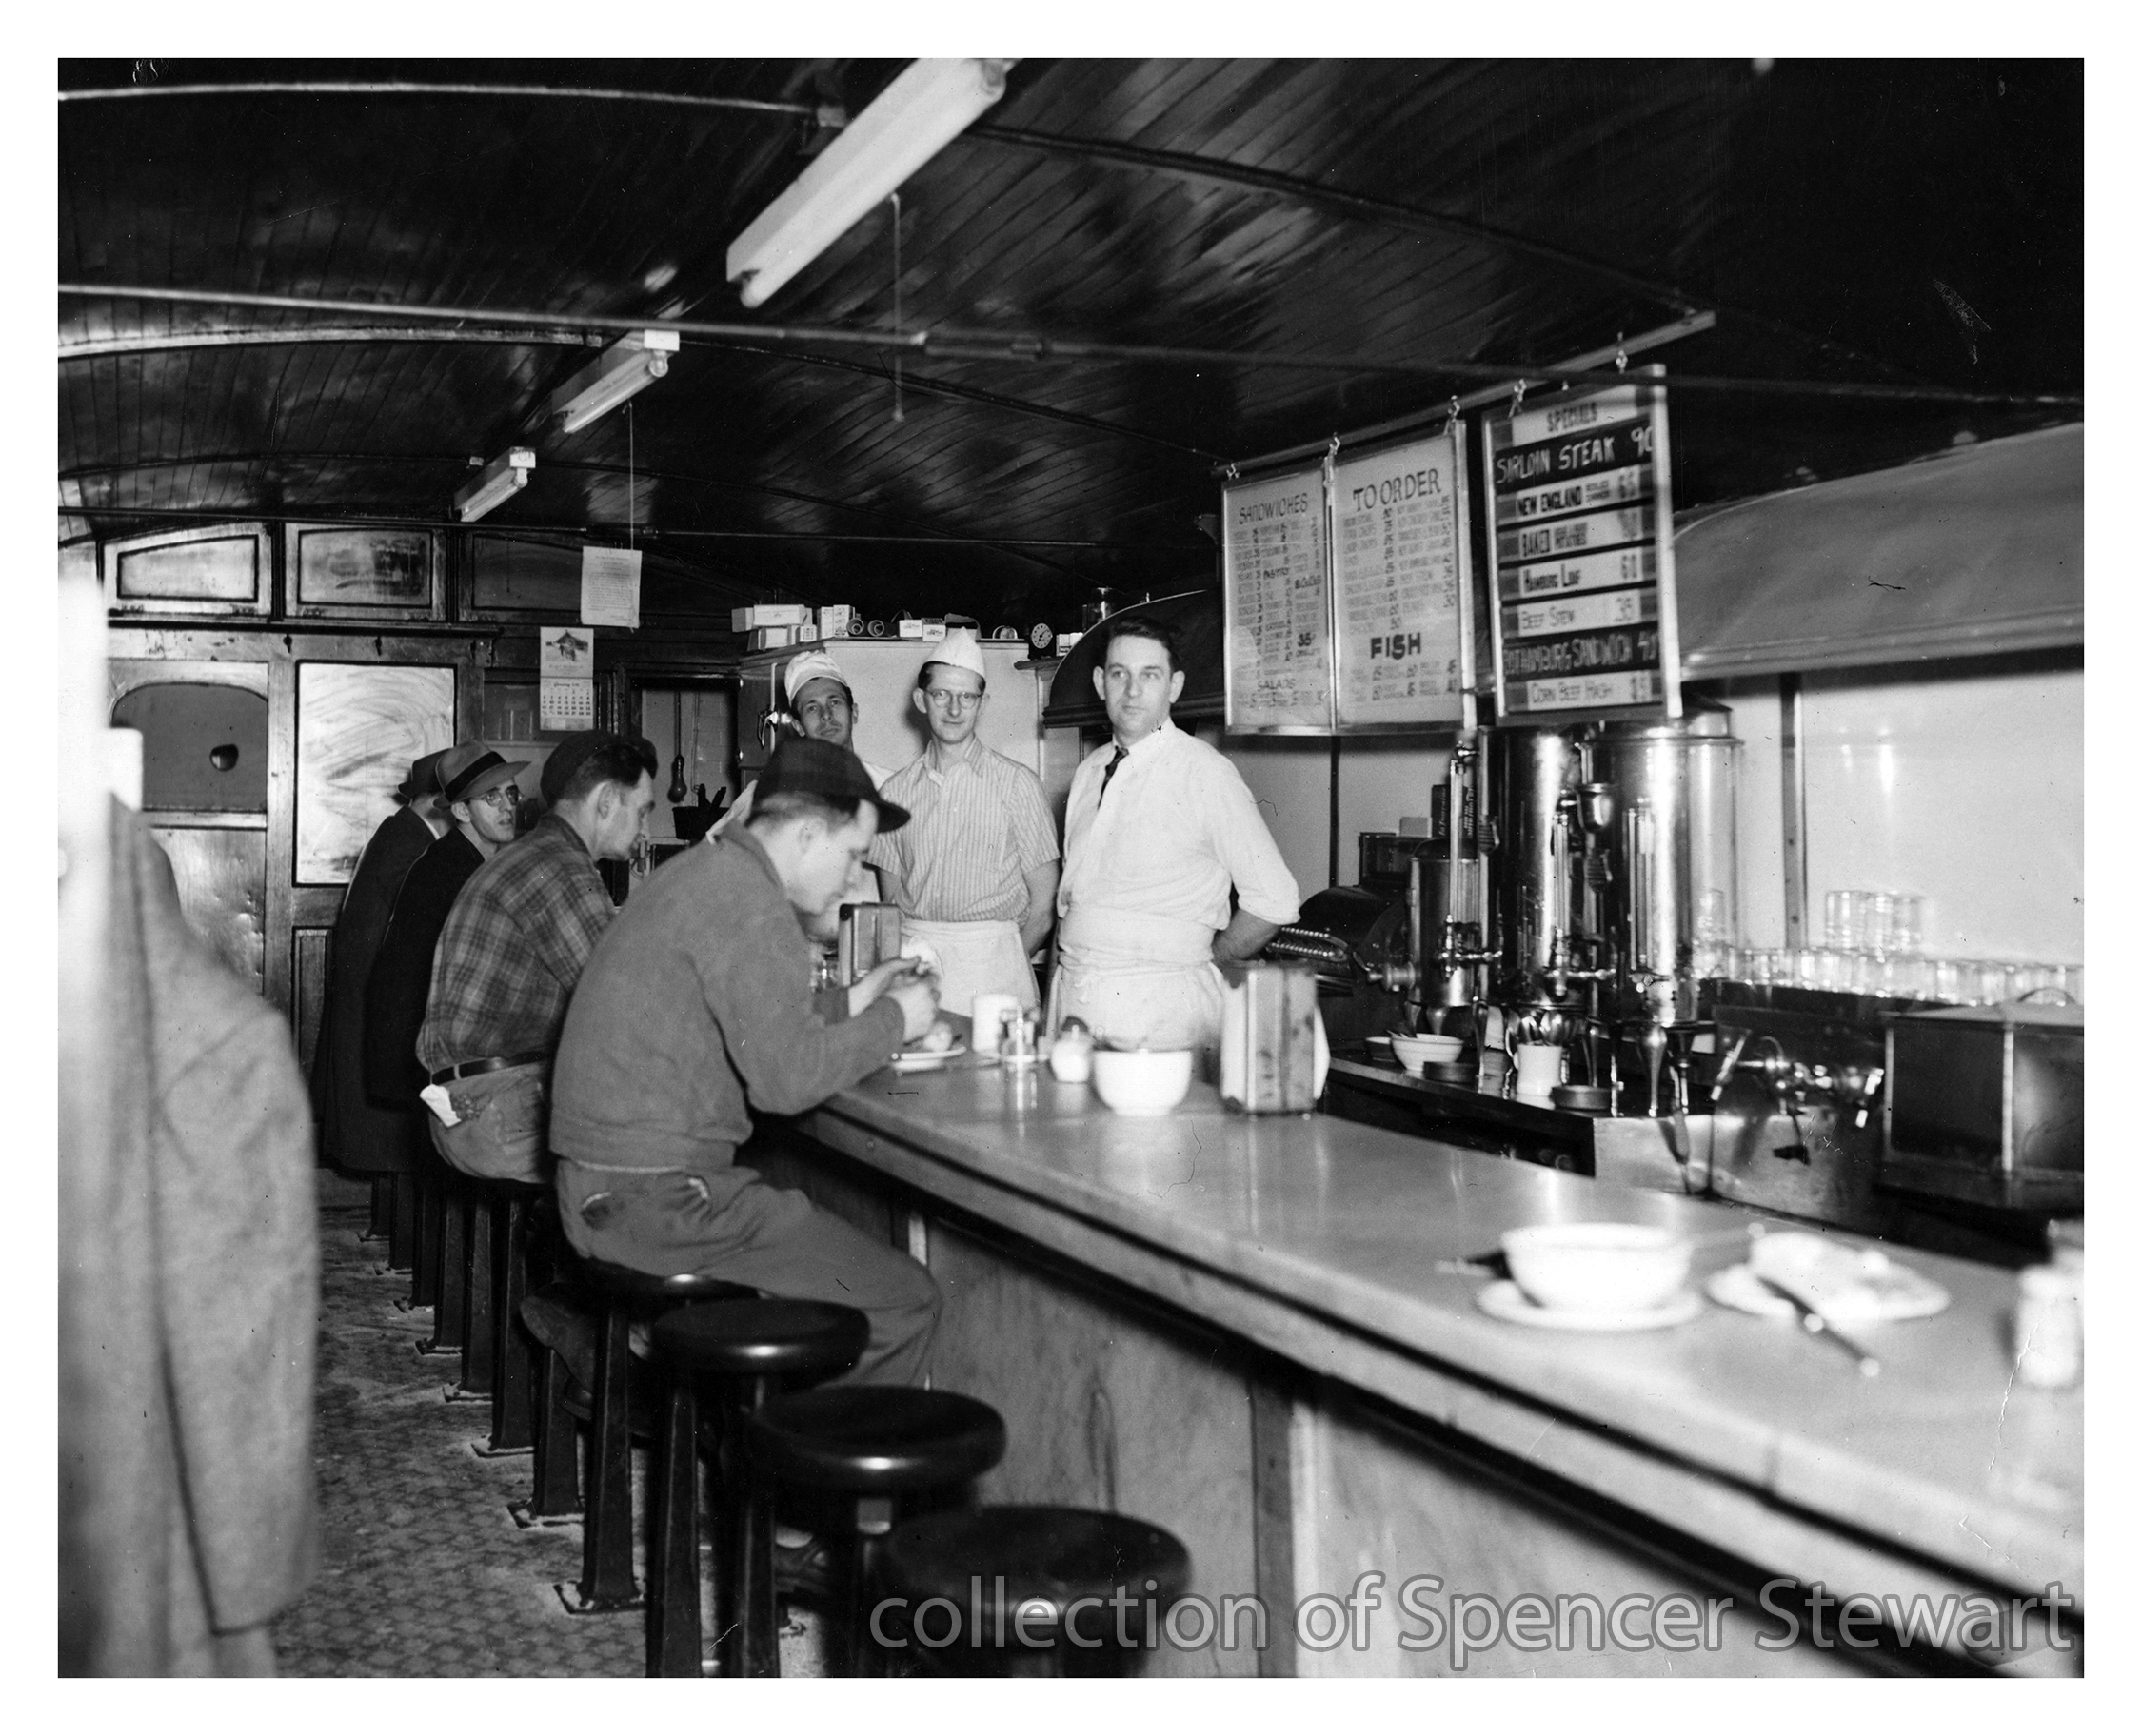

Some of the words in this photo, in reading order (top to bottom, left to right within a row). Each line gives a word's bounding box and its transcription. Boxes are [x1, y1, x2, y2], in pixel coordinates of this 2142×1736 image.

[1496, 448, 1551, 484] SIRLOIN
[1558, 436, 1616, 471] STEAK
[1631, 425, 1655, 458] 90
[1353, 484, 1378, 512] TO
[1380, 468, 1441, 505] ORDER
[1517, 495, 1537, 517] NEW
[1540, 486, 1583, 513] ENGLAND
[1522, 529, 1551, 557] BAKED
[1370, 632, 1422, 660] FISH
